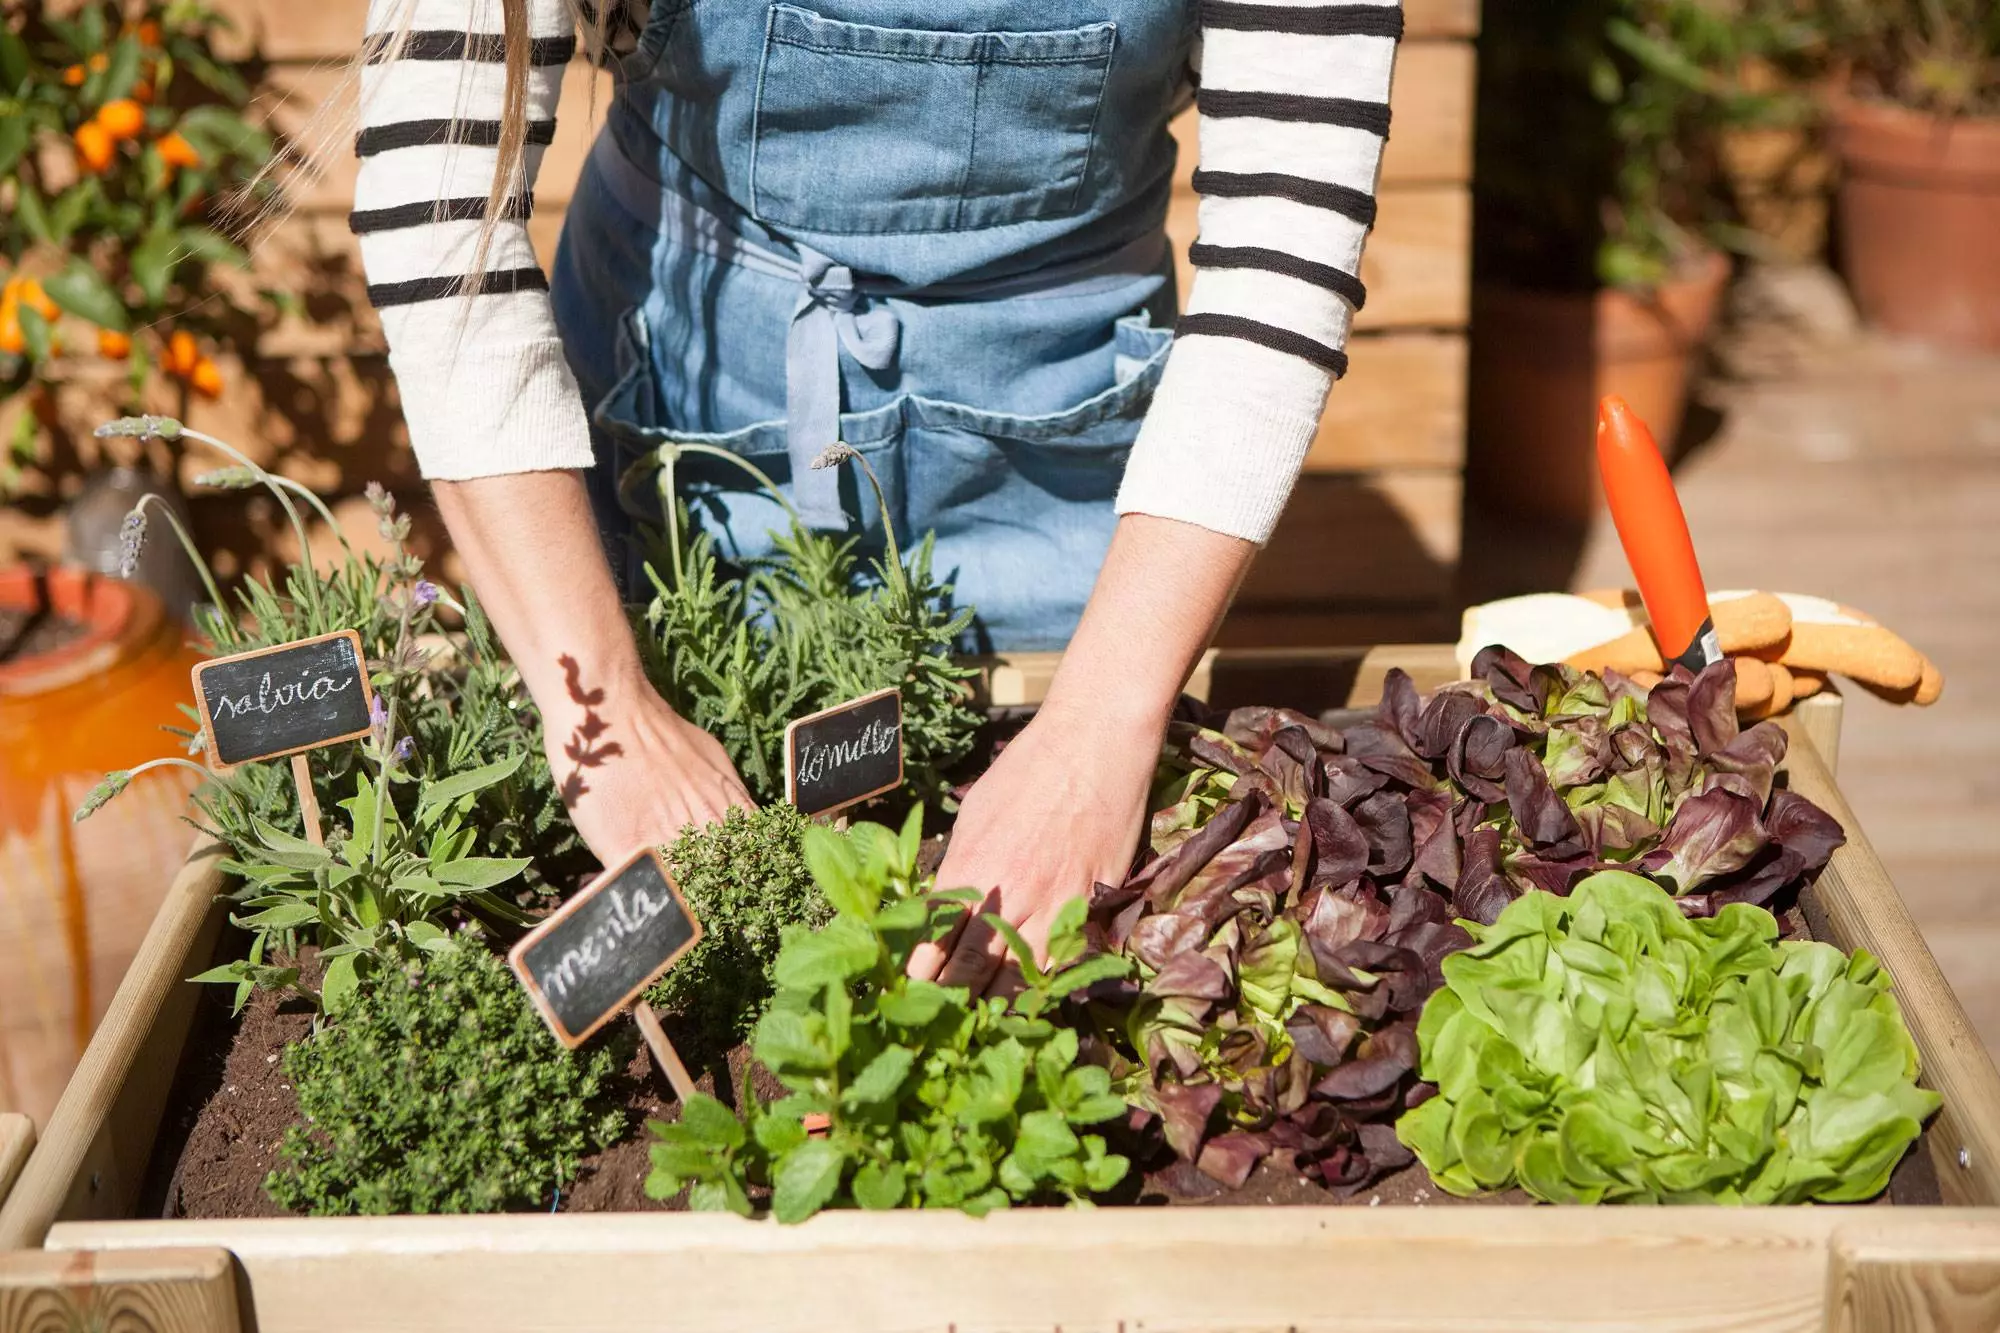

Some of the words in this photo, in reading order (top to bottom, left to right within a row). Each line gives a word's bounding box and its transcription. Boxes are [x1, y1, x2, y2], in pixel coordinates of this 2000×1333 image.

[213, 672, 353, 720] salvia
[797, 719, 902, 786] tomillo
[542, 889, 670, 996] menta
